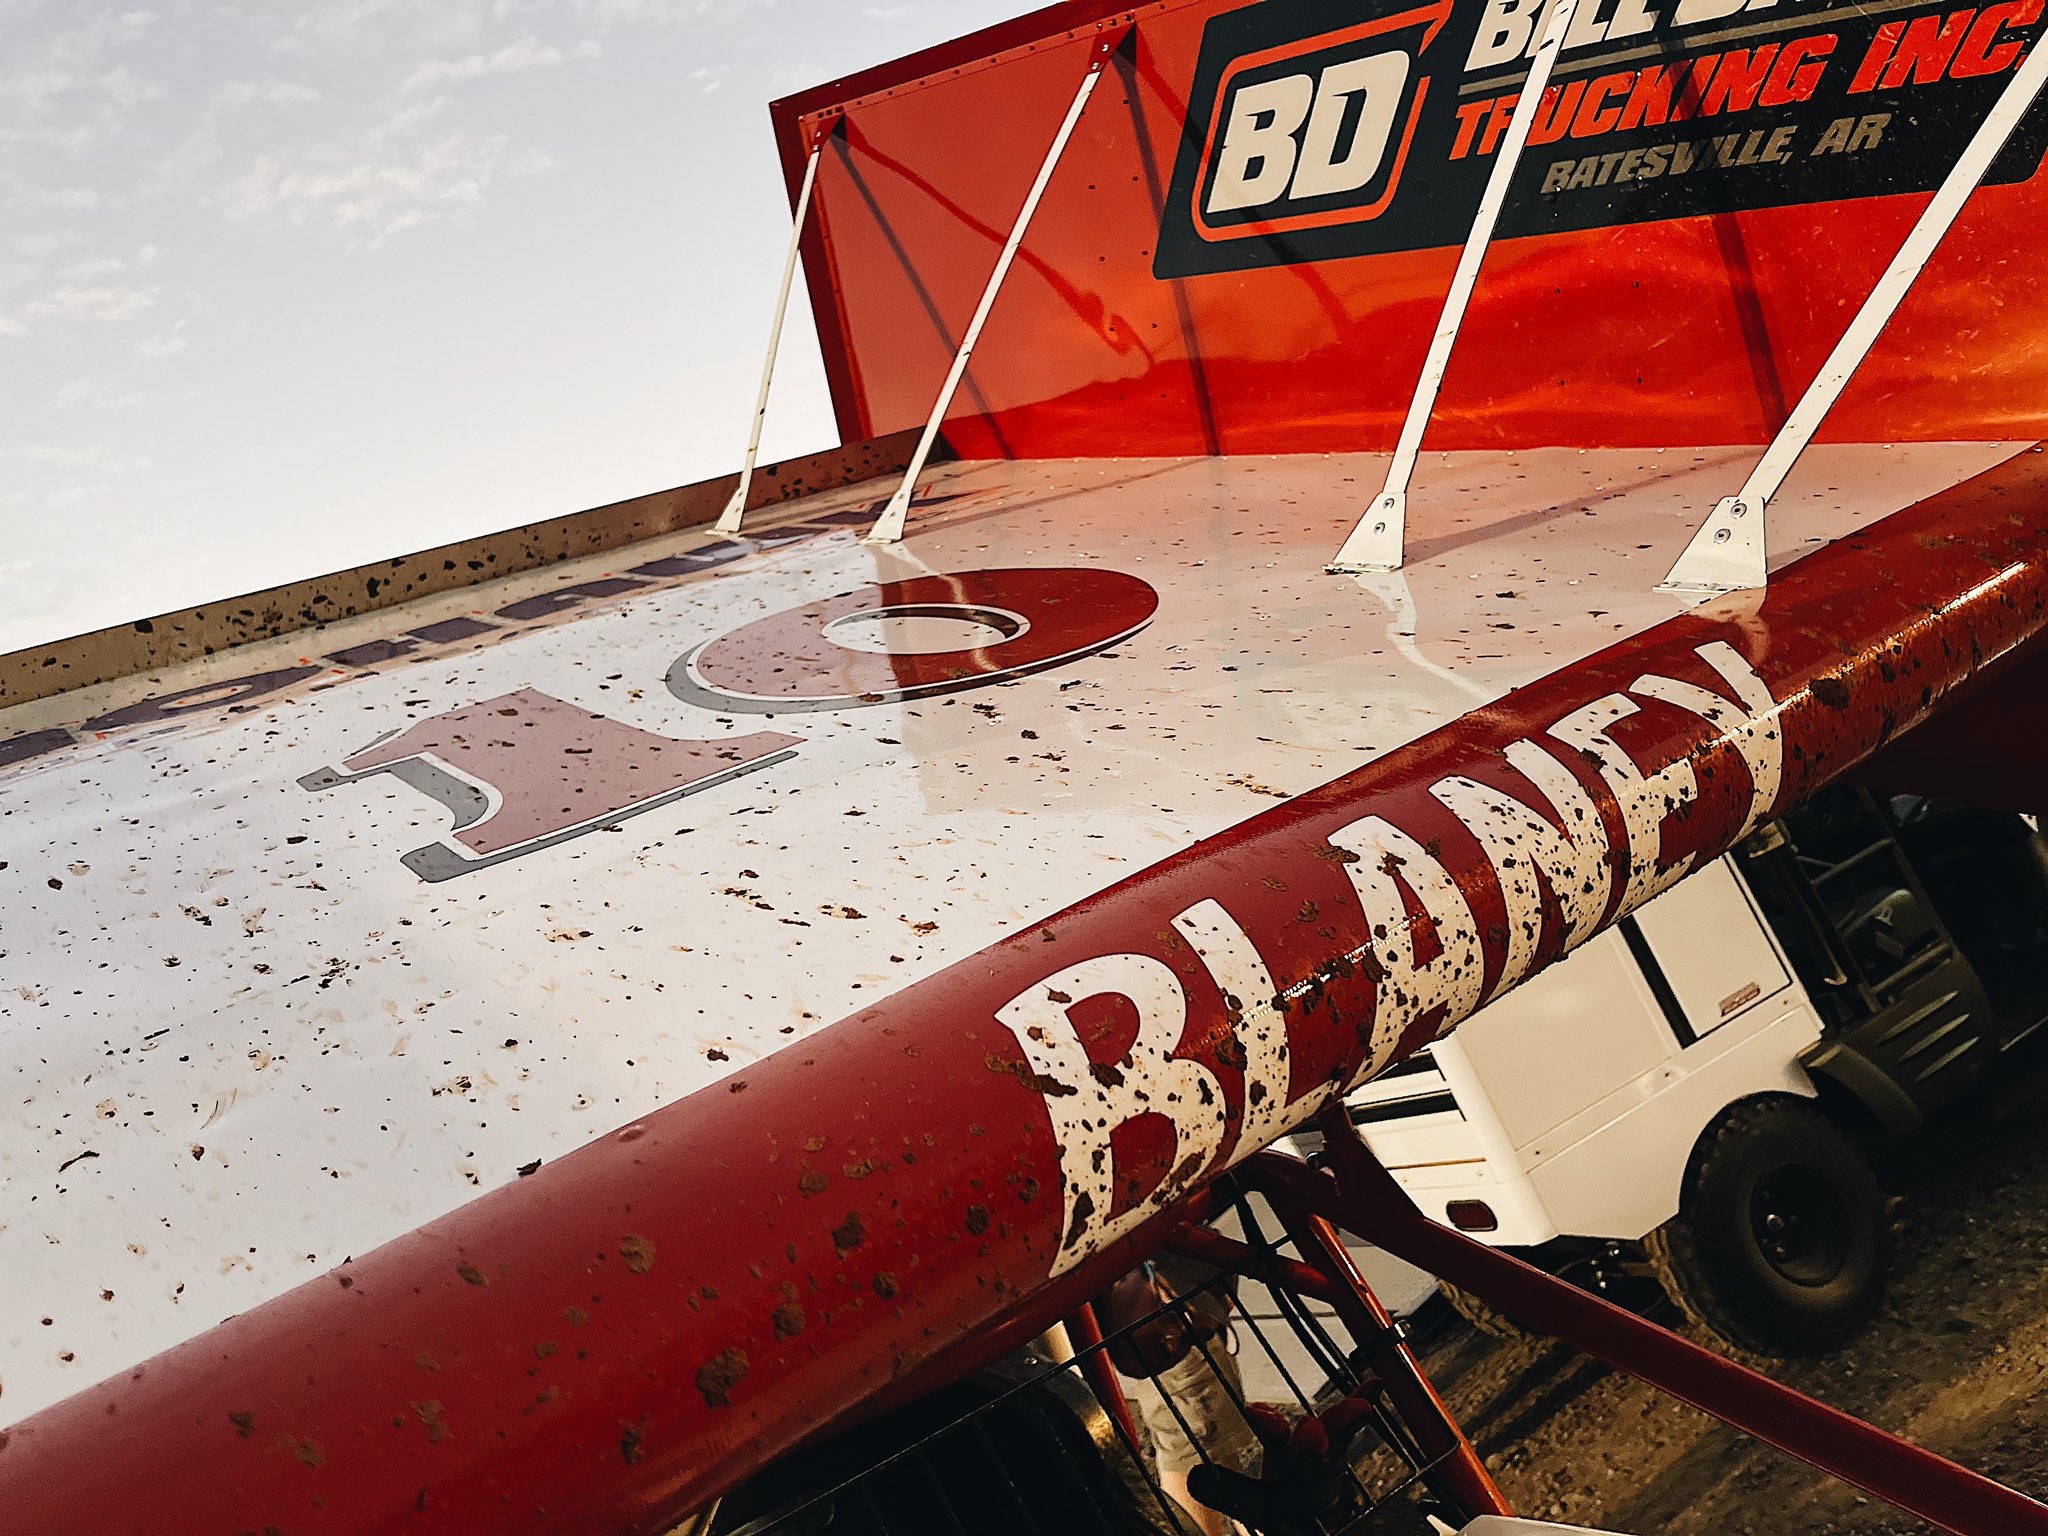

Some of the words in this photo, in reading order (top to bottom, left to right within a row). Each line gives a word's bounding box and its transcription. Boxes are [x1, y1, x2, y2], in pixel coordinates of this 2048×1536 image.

[1206, 49, 1410, 214] BD
[1448, 34, 1838, 160] TRUCKING
[1846, 0, 2045, 94] INC
[1810, 113, 1892, 156] AR
[298, 567, 1159, 881] 10
[994, 641, 1784, 1279] BLANEY
